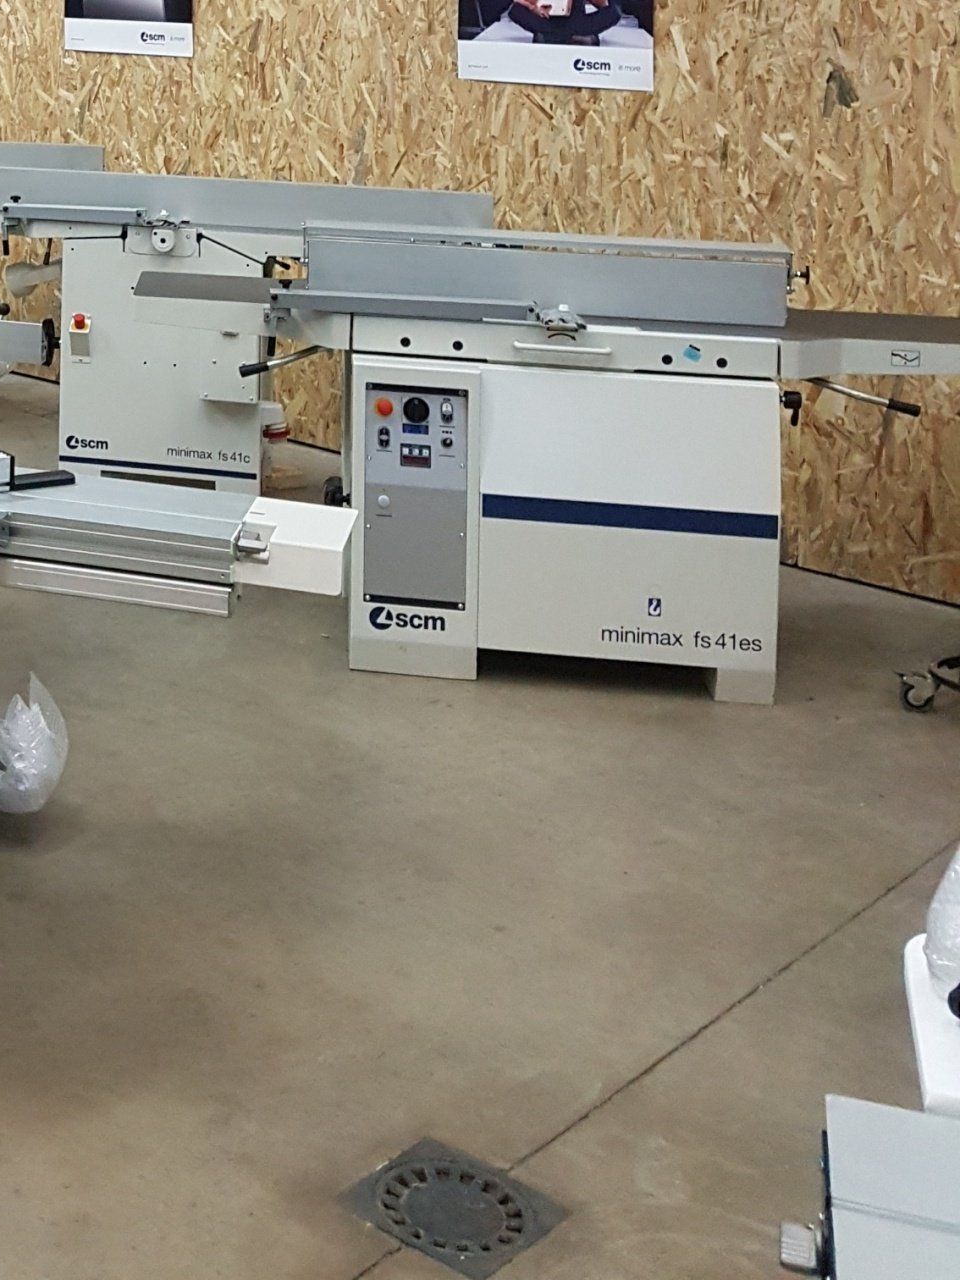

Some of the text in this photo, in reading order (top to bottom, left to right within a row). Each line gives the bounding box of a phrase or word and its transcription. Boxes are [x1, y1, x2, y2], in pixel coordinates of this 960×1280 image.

[149, 33, 165, 41] scm
[586, 60, 611, 71] scm
[81, 439, 108, 450] scm
[167, 446, 212, 460] minimax
[395, 613, 445, 631] scm
[601, 625, 683, 647] minimax
